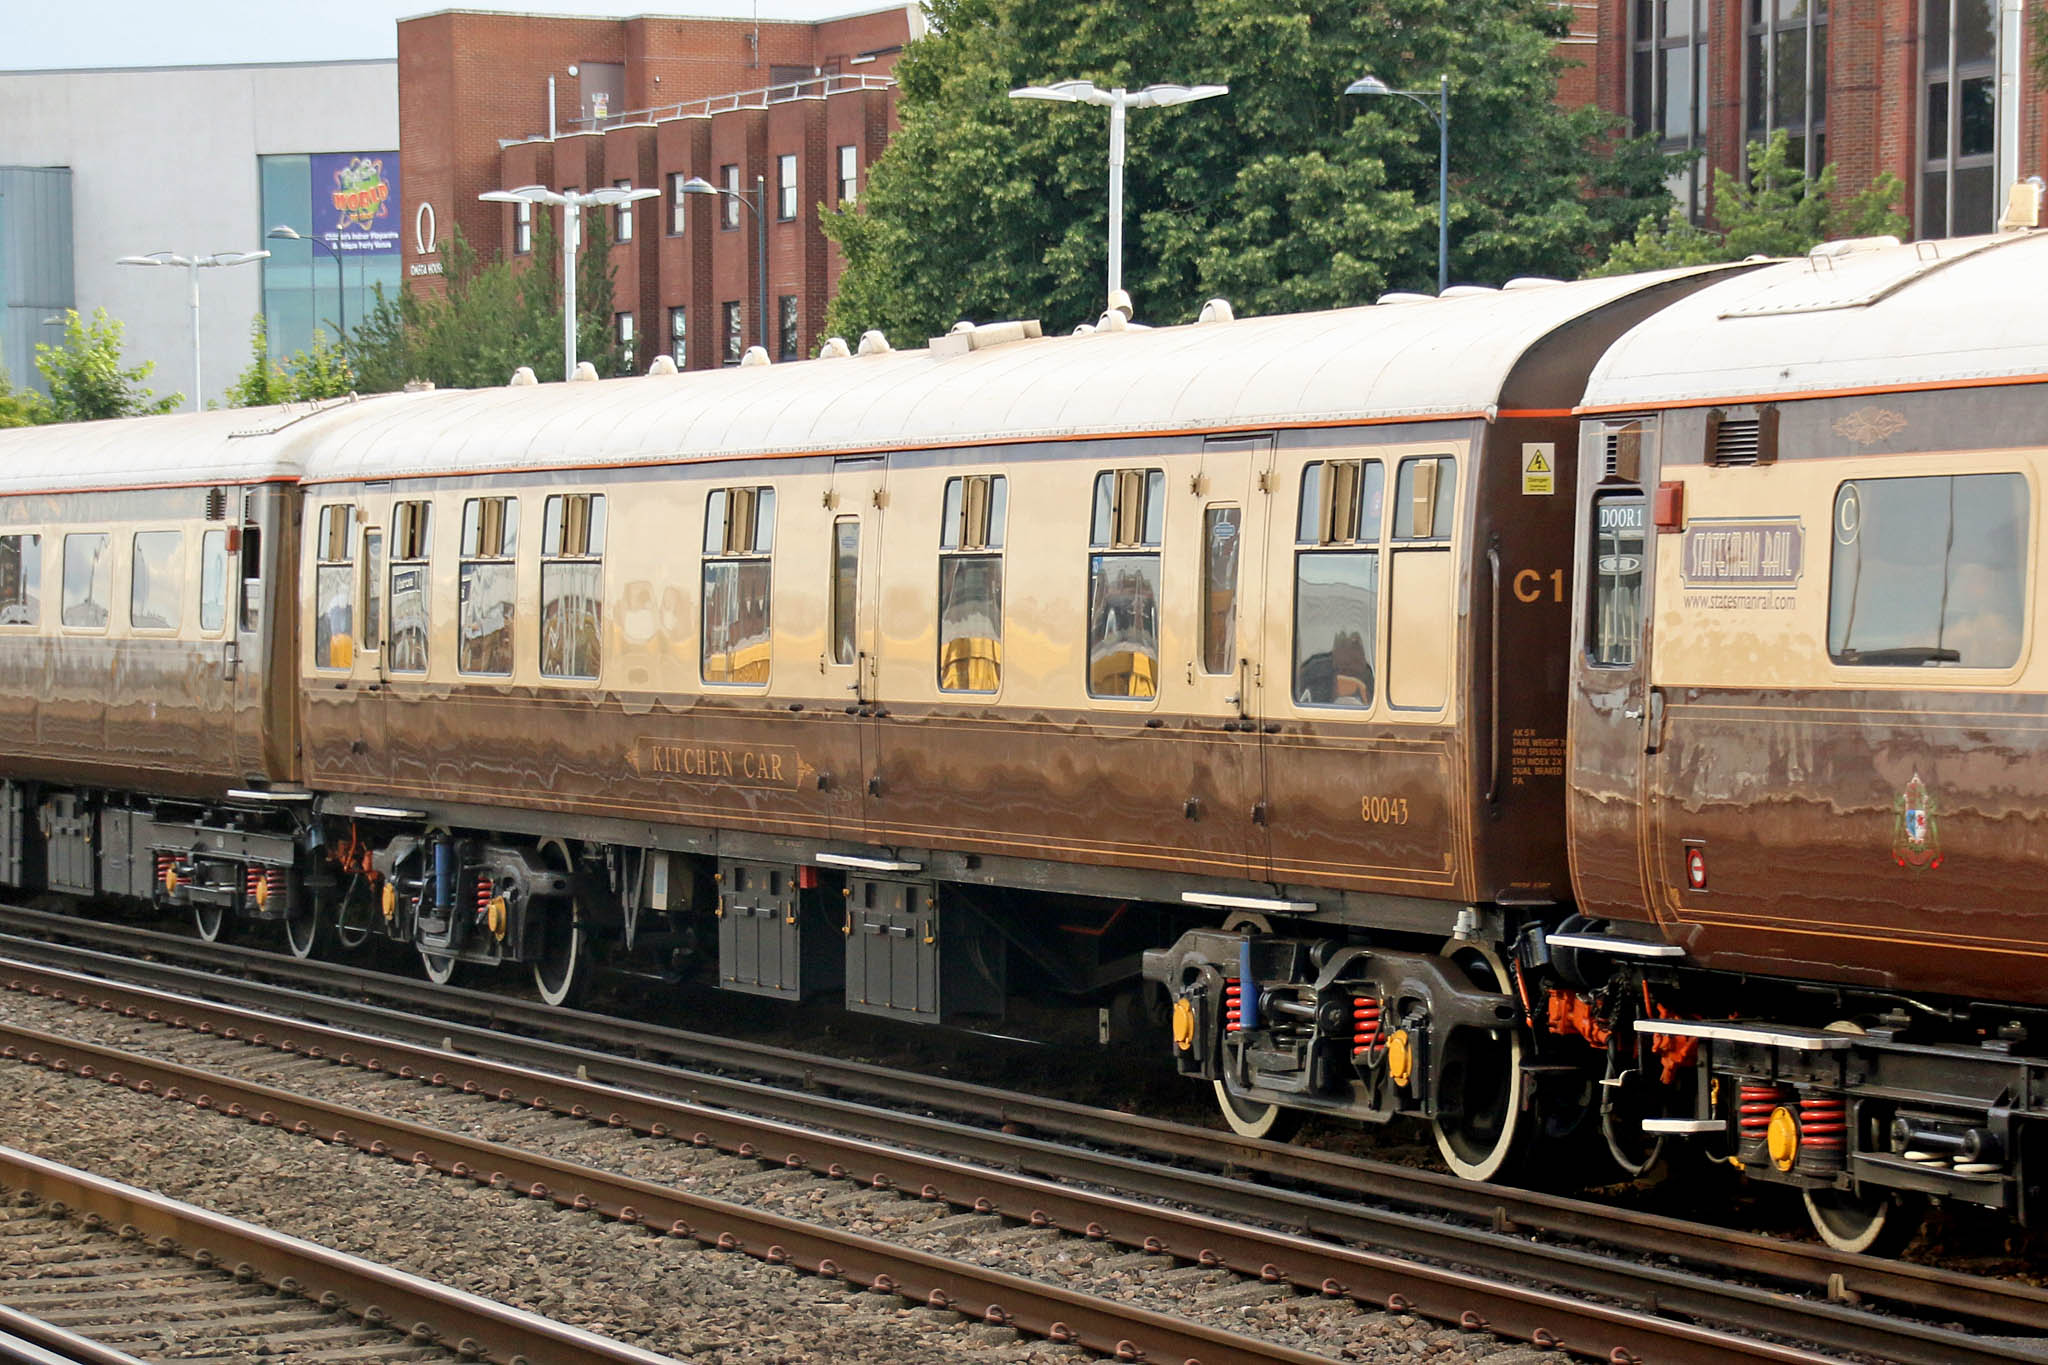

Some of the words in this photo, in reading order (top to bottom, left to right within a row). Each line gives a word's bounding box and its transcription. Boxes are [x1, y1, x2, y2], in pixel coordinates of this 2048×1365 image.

[332, 183, 388, 211] WORLD
[1601, 508, 1635, 528] DOOR
[1637, 508, 1643, 527] 1
[1841, 498, 1855, 531] C
[1692, 531, 1760, 577] STATESMAN
[1761, 531, 1792, 577] RAIL
[1683, 591, 1797, 610] www.statesmanrail.com
[652, 745, 734, 777] KITCHEN
[743, 752, 784, 781] CAR
[1361, 795, 1408, 825] 80043
